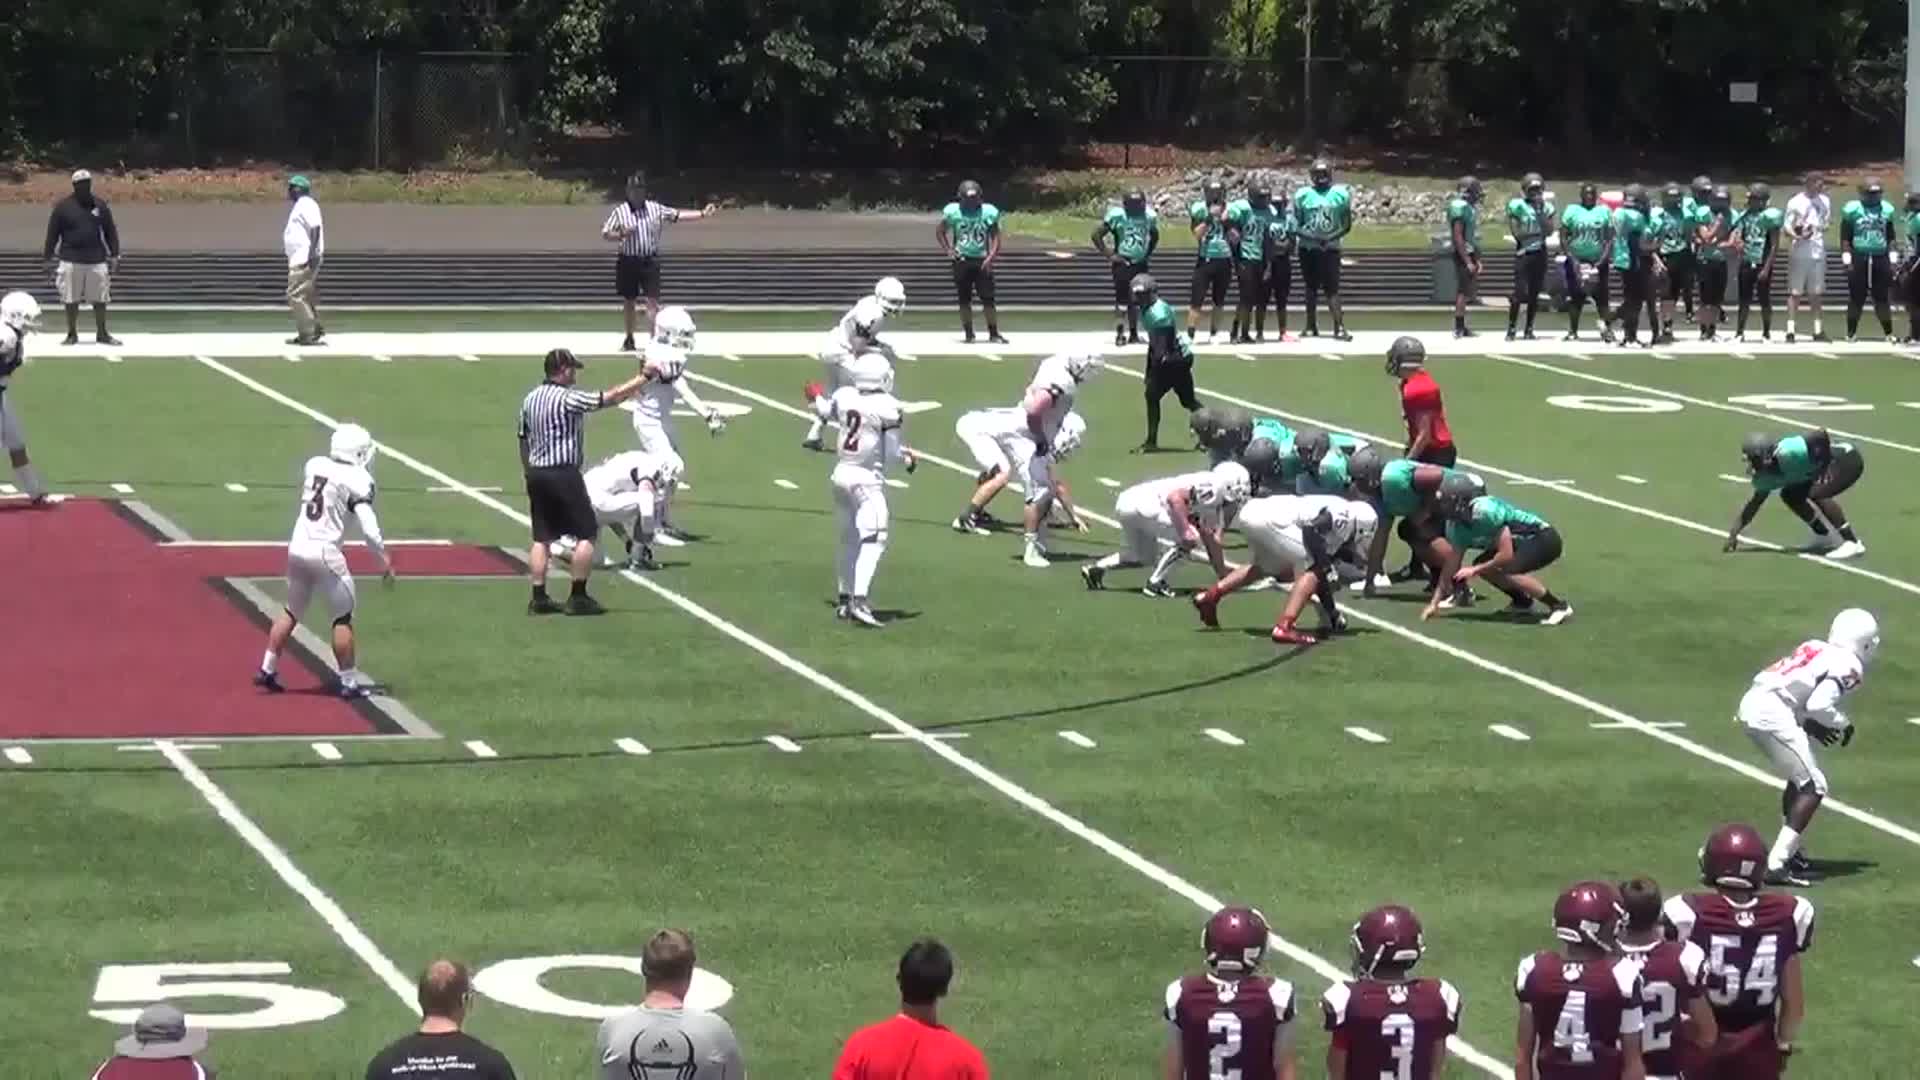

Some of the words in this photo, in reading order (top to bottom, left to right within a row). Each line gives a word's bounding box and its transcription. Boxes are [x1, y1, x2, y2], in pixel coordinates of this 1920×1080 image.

[842, 408, 862, 452] 2
[306, 475, 329, 522] 3
[1706, 934, 1779, 1006] 54
[1207, 1011, 1243, 1080] 2
[1380, 1012, 1416, 1080] 3
[1553, 990, 1595, 1063] 4
